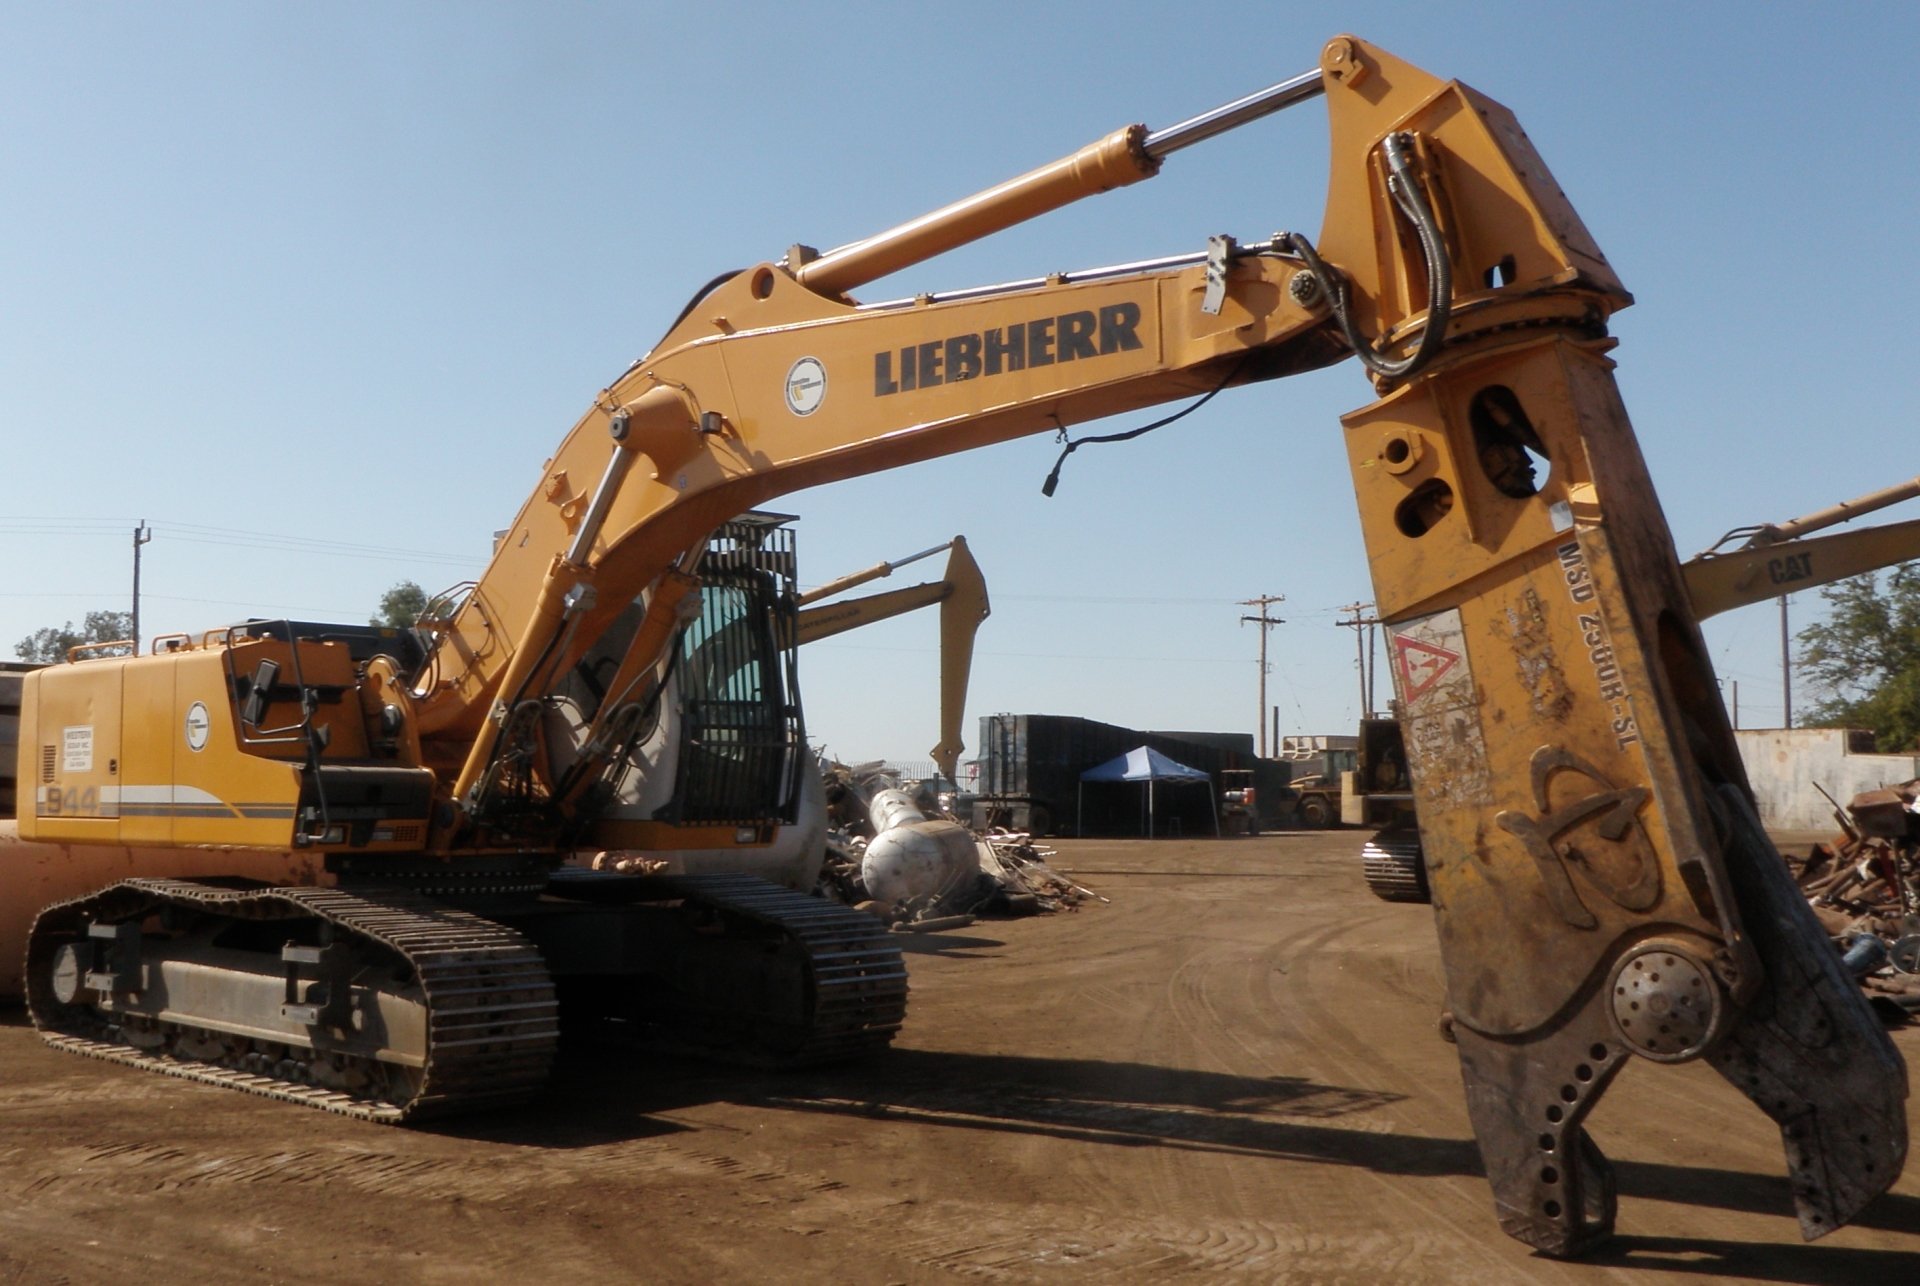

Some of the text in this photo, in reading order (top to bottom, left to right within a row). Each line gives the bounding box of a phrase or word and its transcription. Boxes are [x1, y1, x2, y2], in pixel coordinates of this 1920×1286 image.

[875, 302, 1143, 397] LIEBHERR
[1557, 541, 1596, 604] MSD
[1768, 552, 1812, 584] CAT
[47, 787, 97, 814] 944
